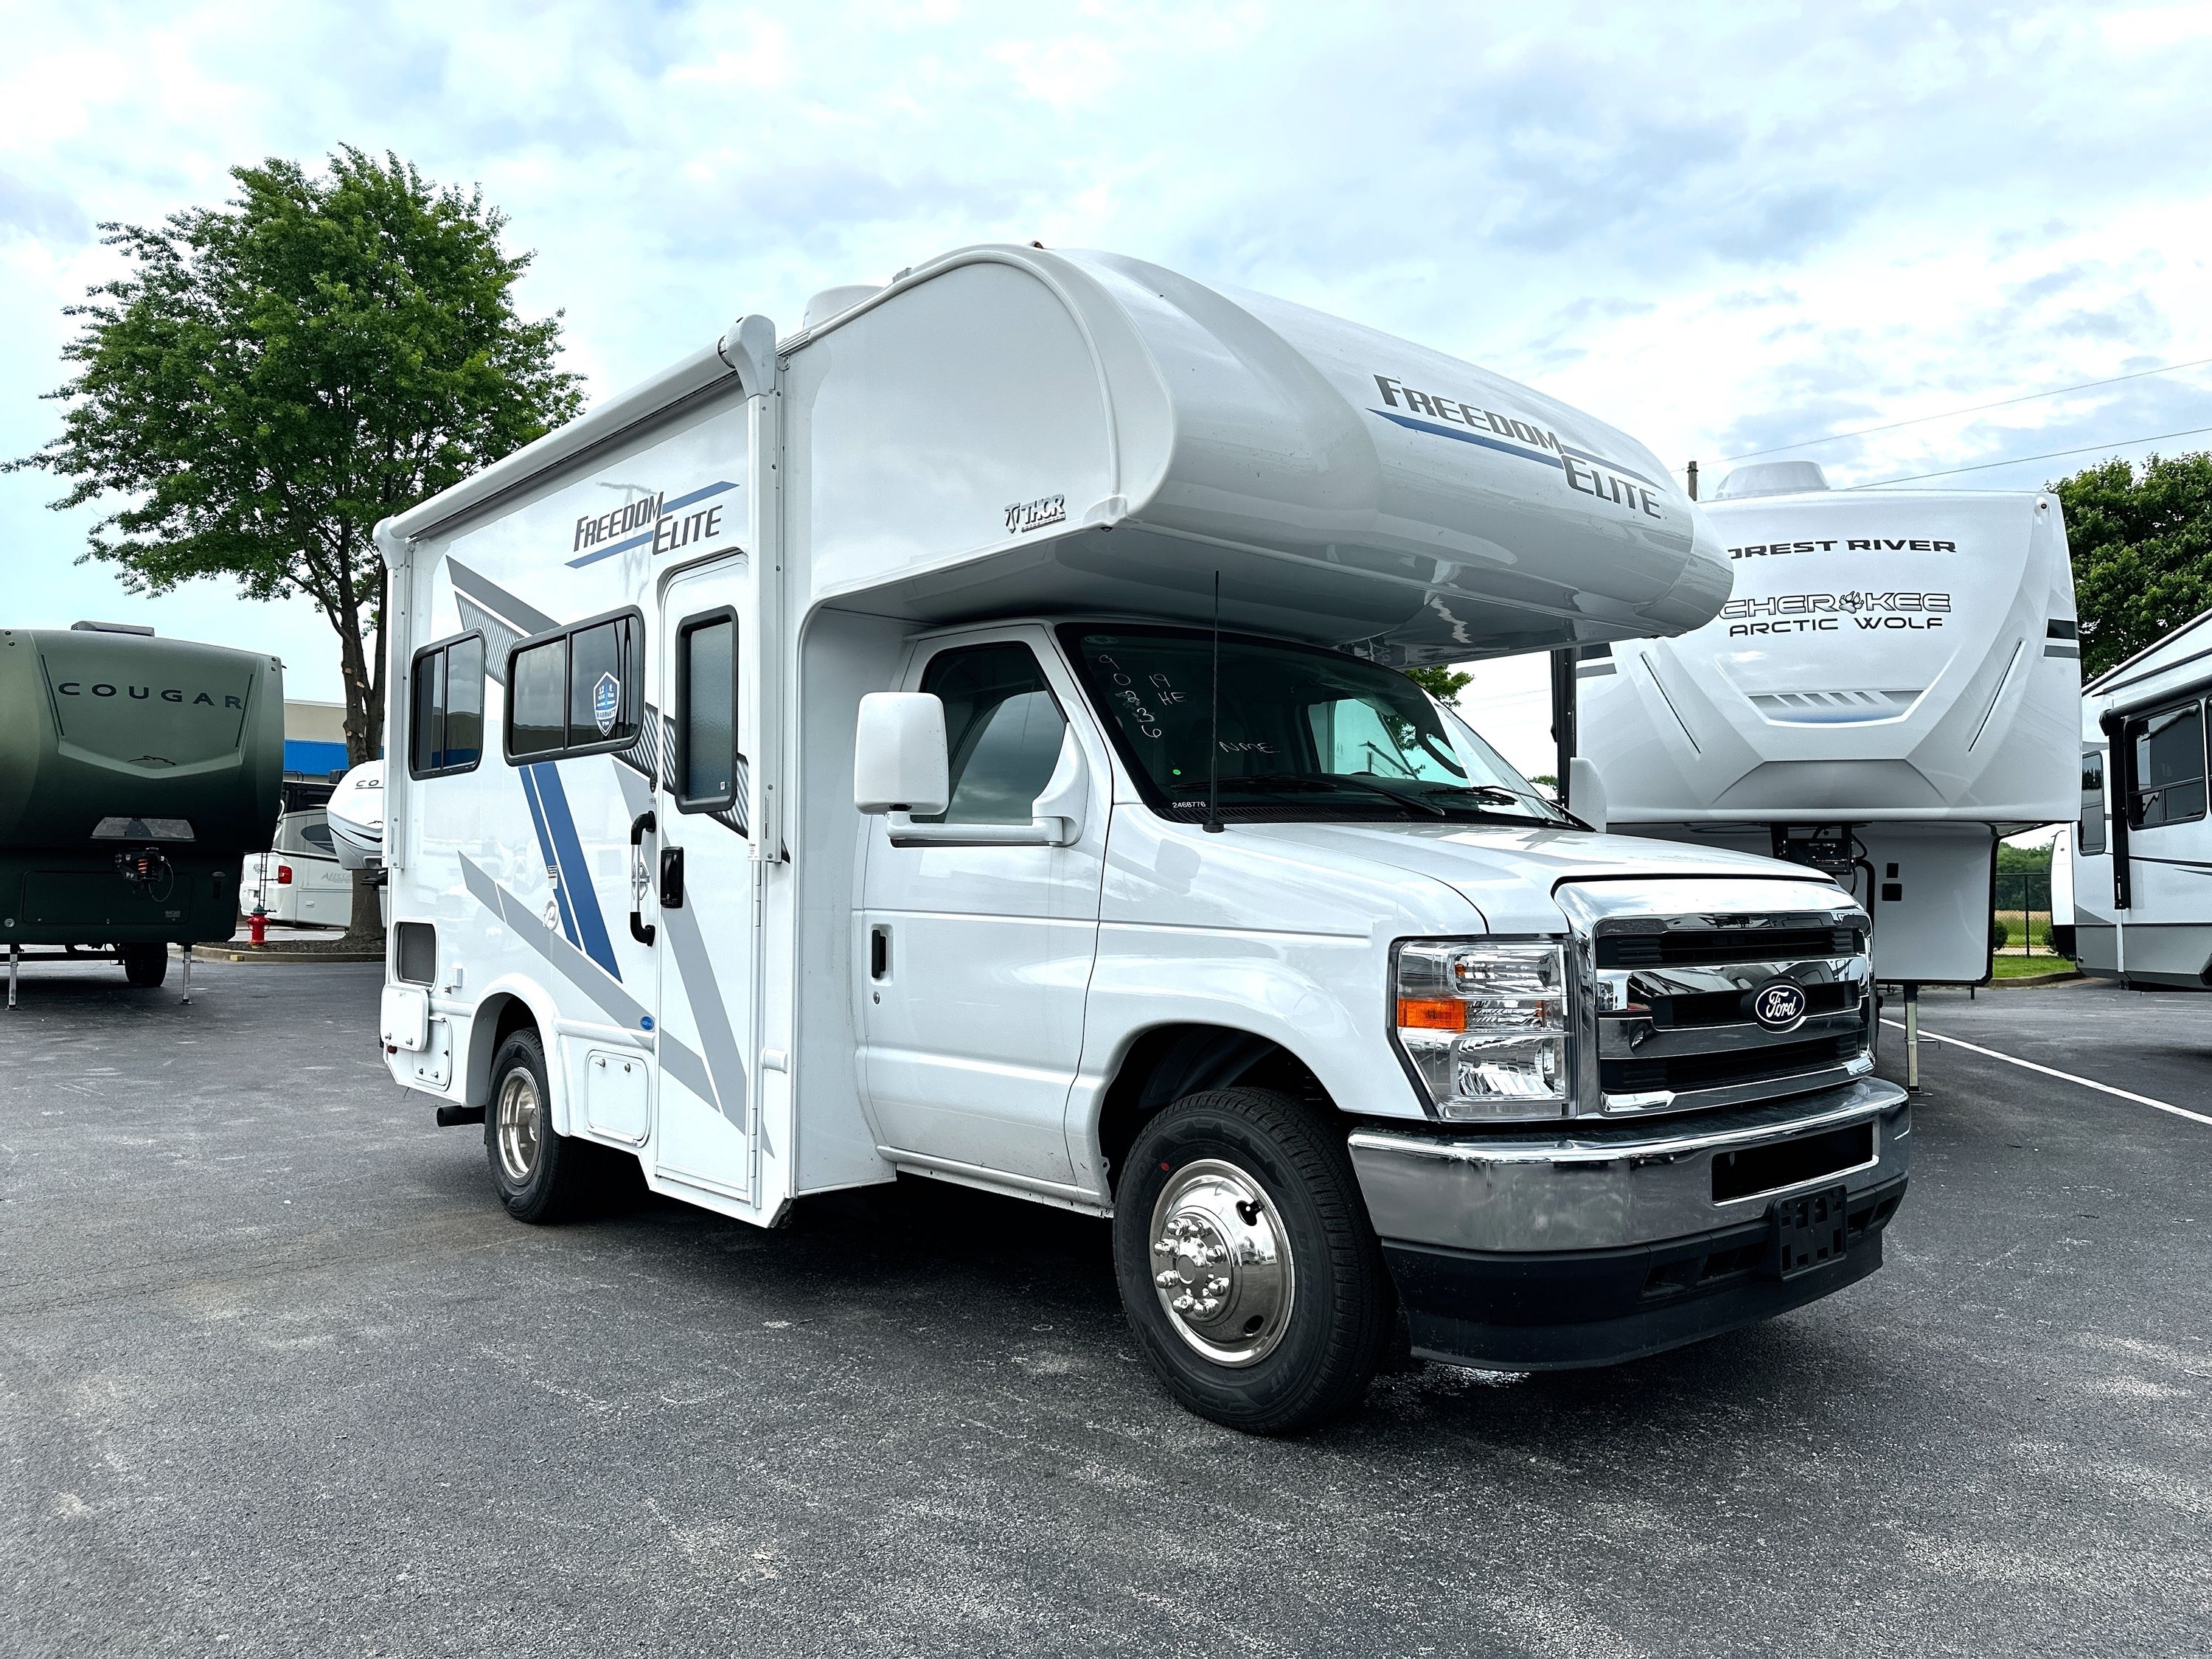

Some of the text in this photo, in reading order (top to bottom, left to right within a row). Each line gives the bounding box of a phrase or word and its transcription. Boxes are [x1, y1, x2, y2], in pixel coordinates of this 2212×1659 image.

[1373, 374, 1565, 454] FREEDOM
[1562, 454, 1661, 519] ELITE
[574, 491, 664, 552] FREEDOM
[1021, 493, 1065, 524] THOR
[653, 505, 723, 555] ELITE
[1728, 540, 1957, 559] OREST RIVER
[1729, 617, 1943, 637] ARCTIC WOLF
[58, 682, 243, 709] COUGAR
[1766, 991, 1797, 1018] Ford
